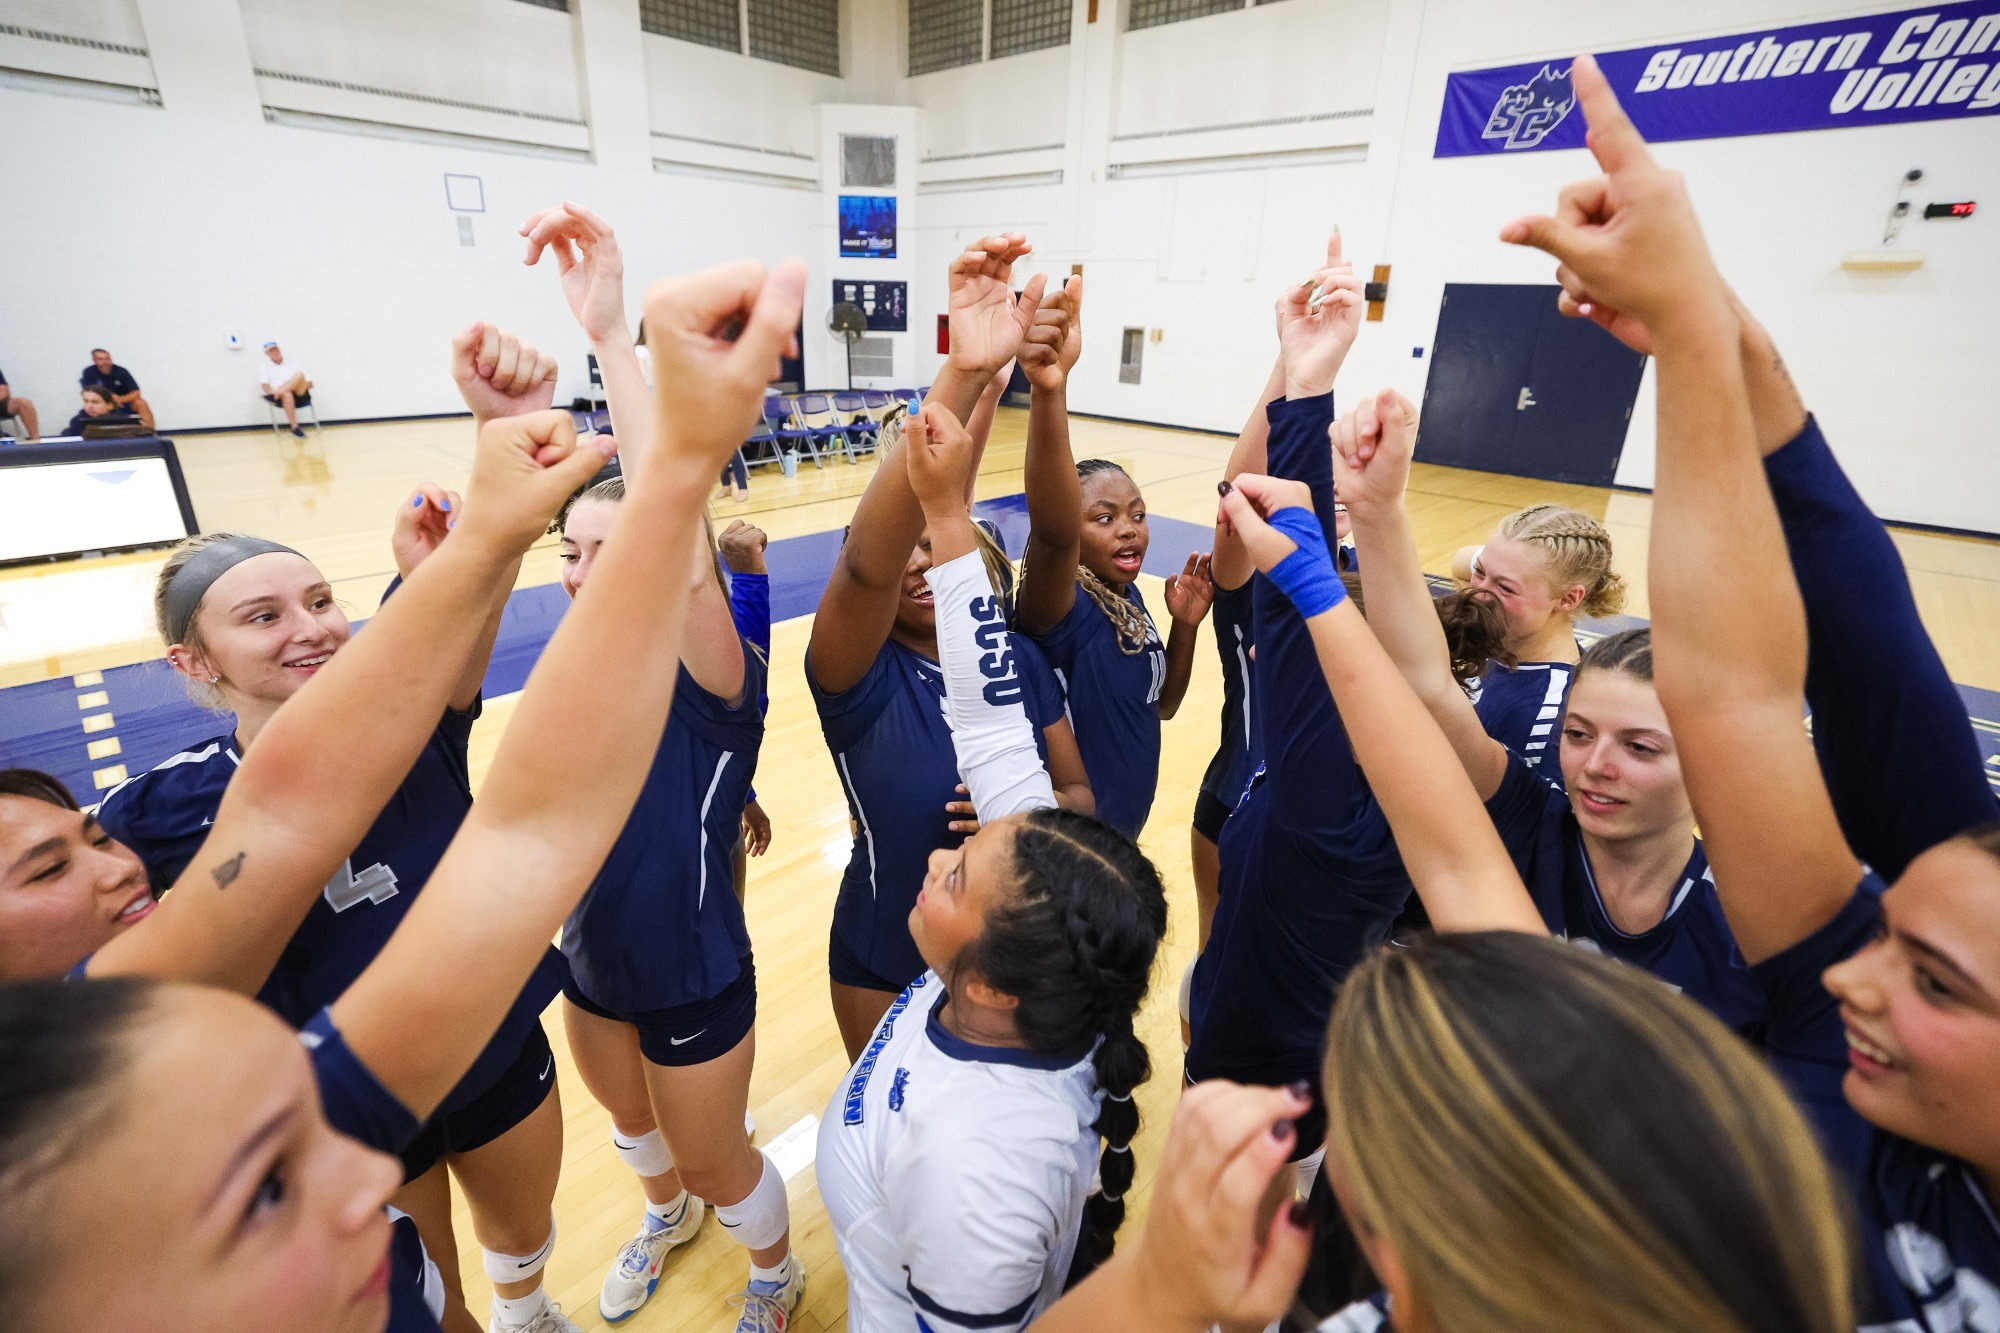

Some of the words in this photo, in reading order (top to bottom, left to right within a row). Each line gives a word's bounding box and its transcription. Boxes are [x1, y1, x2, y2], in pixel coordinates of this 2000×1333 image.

[1635, 32, 1873, 93] Southern
[1878, 13, 2000, 65] Con
[969, 595, 1023, 706] SCSU
